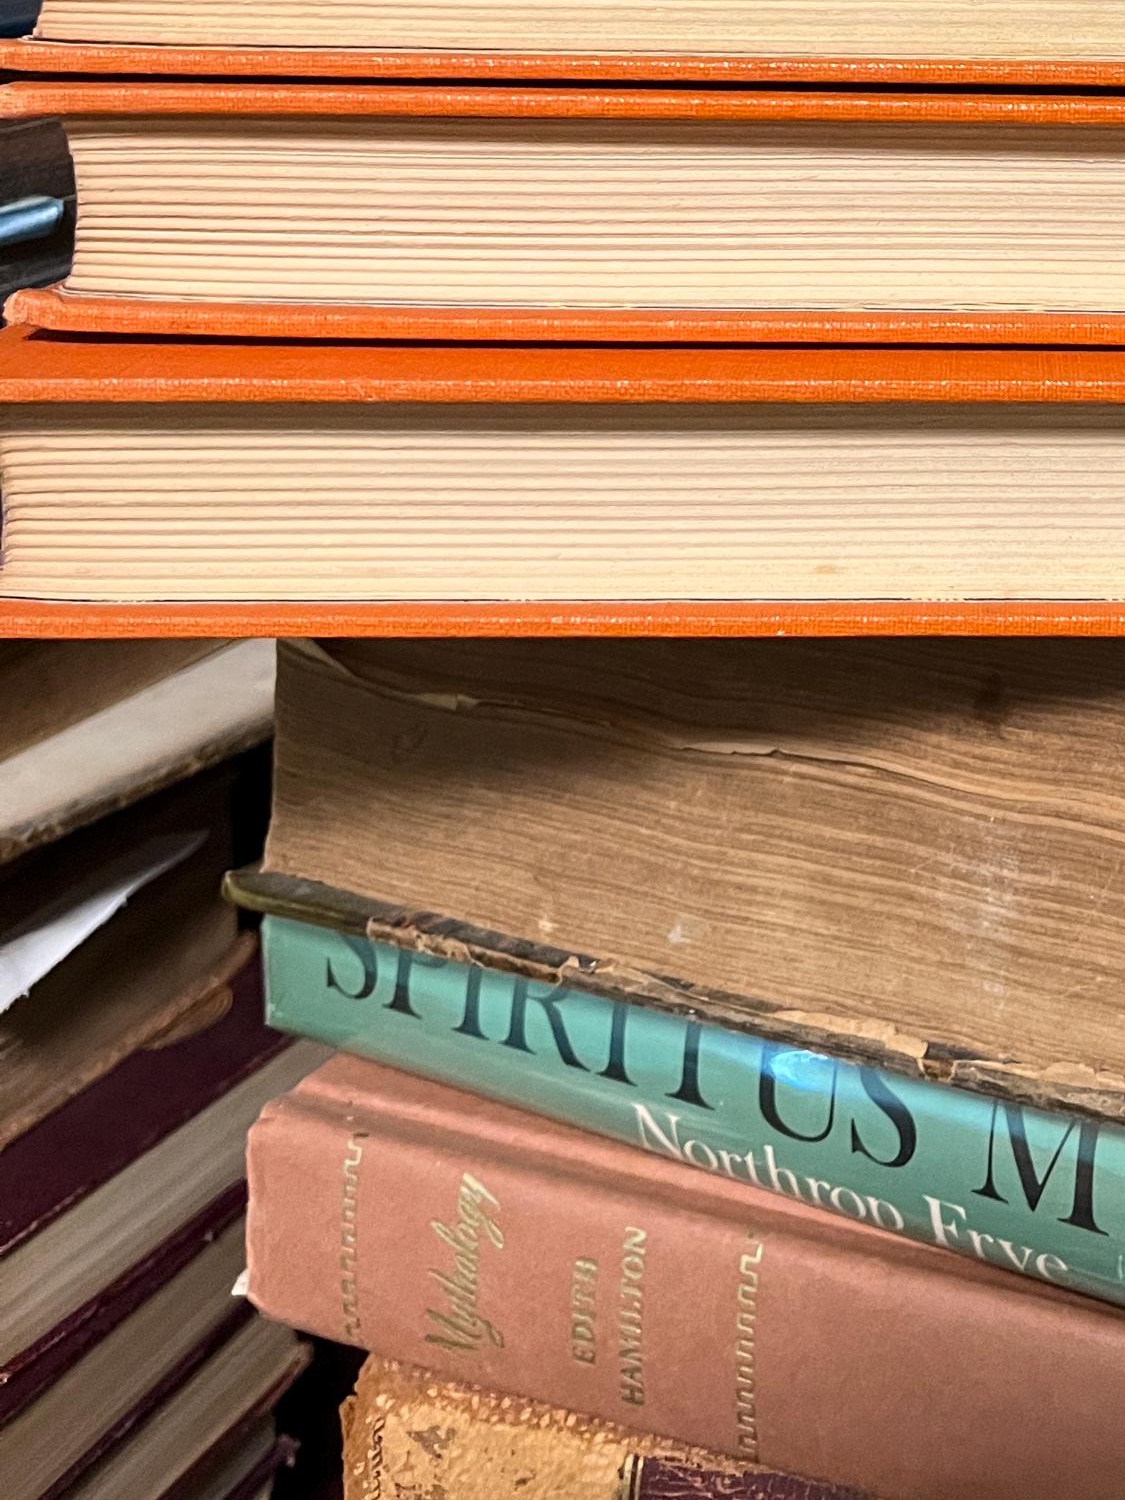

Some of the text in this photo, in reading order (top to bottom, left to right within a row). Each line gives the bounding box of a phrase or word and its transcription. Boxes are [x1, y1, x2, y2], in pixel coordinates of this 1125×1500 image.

[424, 1172, 505, 1352] Mythology
[571, 1256, 598, 1367] EDITH
[618, 1226, 648, 1407] HAMILTON
